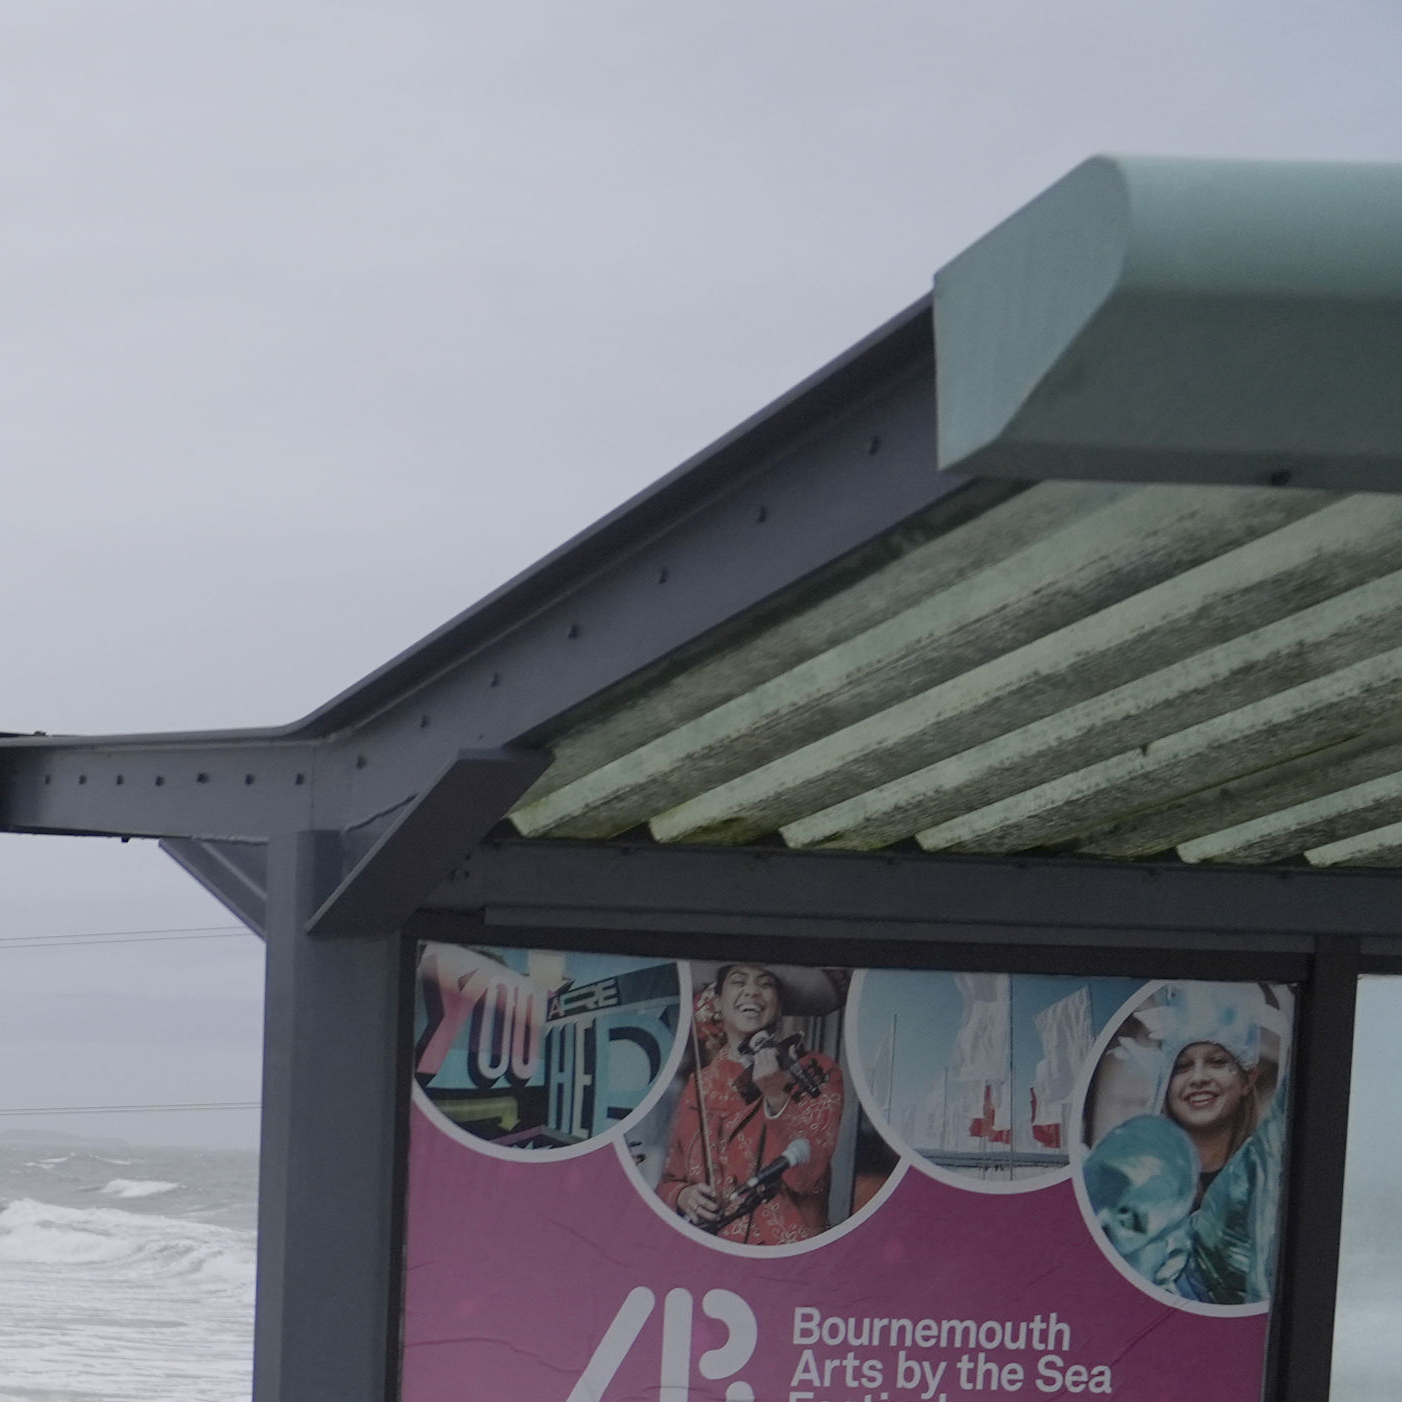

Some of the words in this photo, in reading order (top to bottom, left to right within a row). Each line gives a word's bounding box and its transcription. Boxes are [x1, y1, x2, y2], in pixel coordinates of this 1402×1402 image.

[792, 1306, 1072, 1351] Bournemouth
[790, 1349, 884, 1389] Arts
[896, 1350, 947, 1400] by
[956, 1351, 1025, 1392] the
[1034, 1353, 1113, 1394] Sea
